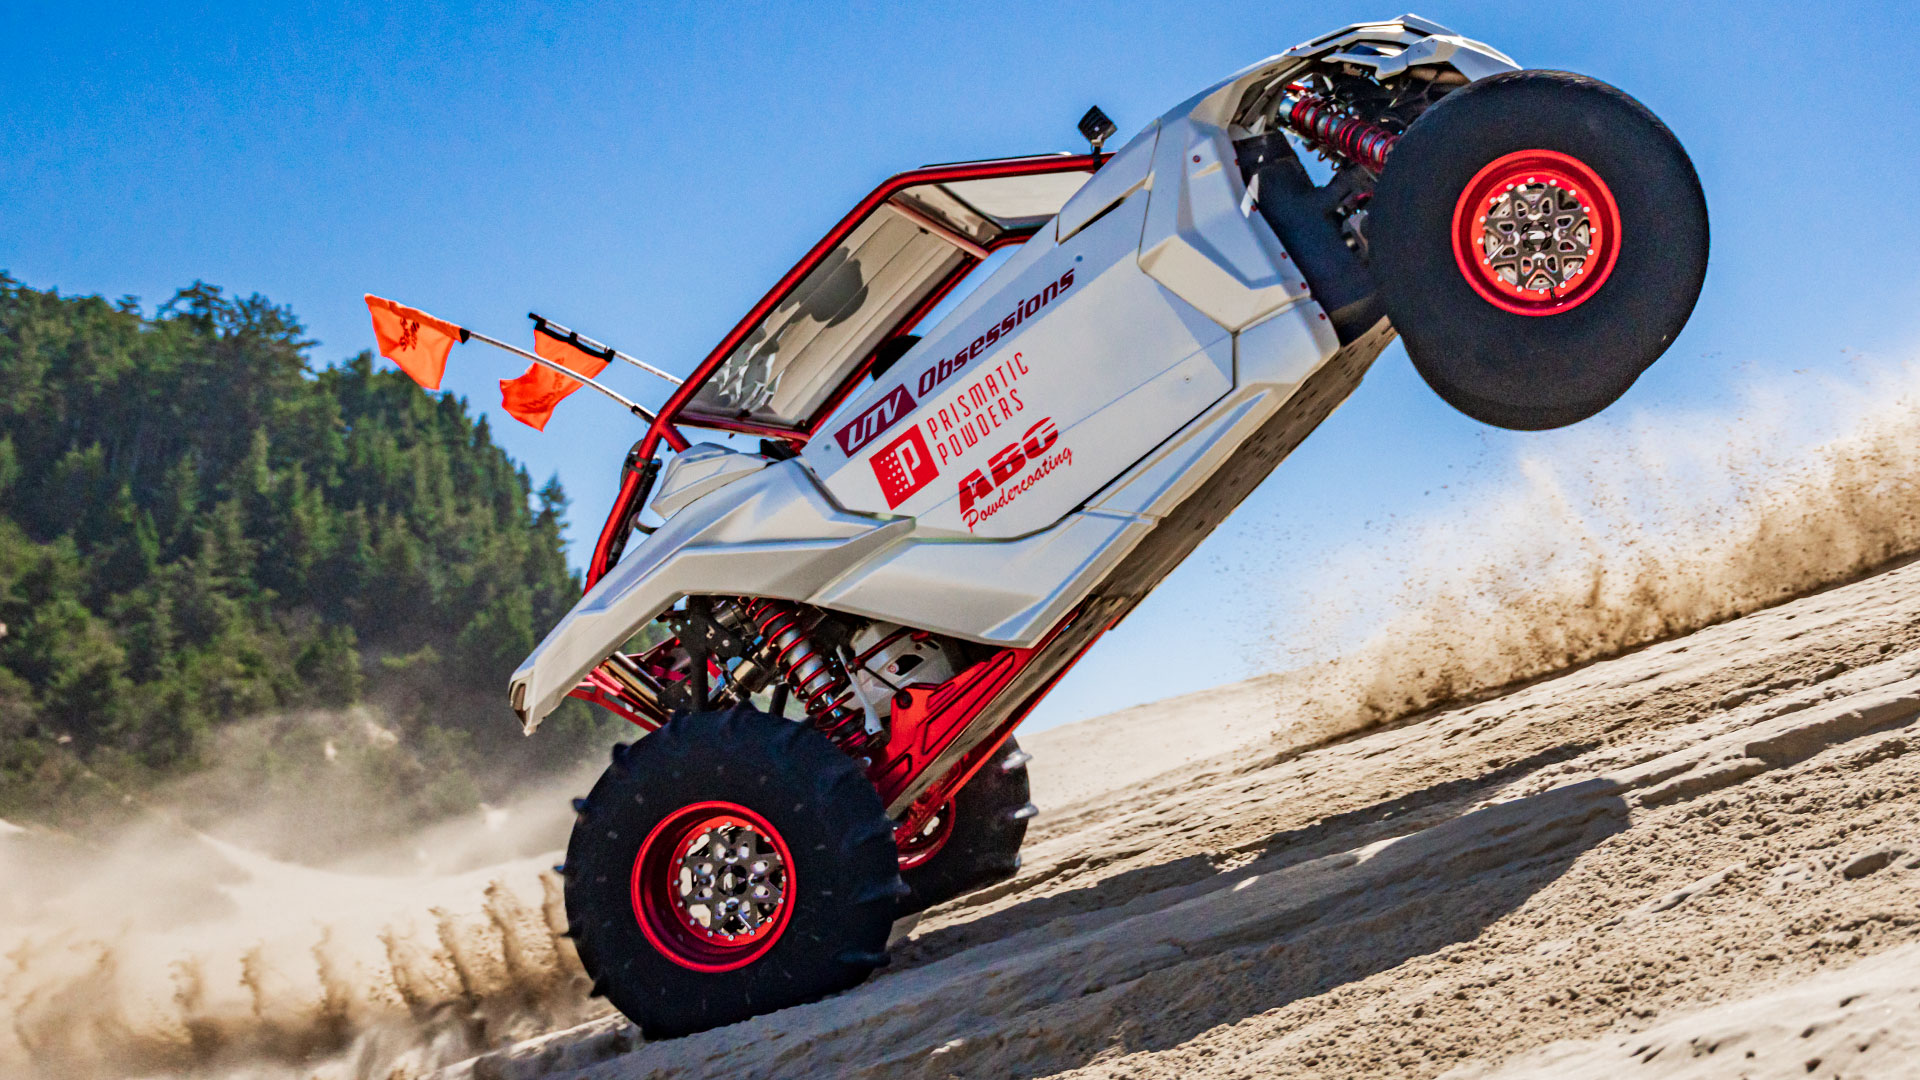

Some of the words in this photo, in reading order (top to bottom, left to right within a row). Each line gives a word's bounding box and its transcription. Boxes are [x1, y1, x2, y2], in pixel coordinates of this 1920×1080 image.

[847, 390, 902, 451] UTV
[917, 268, 1075, 398] Obsessions
[926, 352, 1029, 440] PRISMATIC
[936, 388, 1024, 466] POWDERS
[961, 447, 1073, 533] Powdercoating
